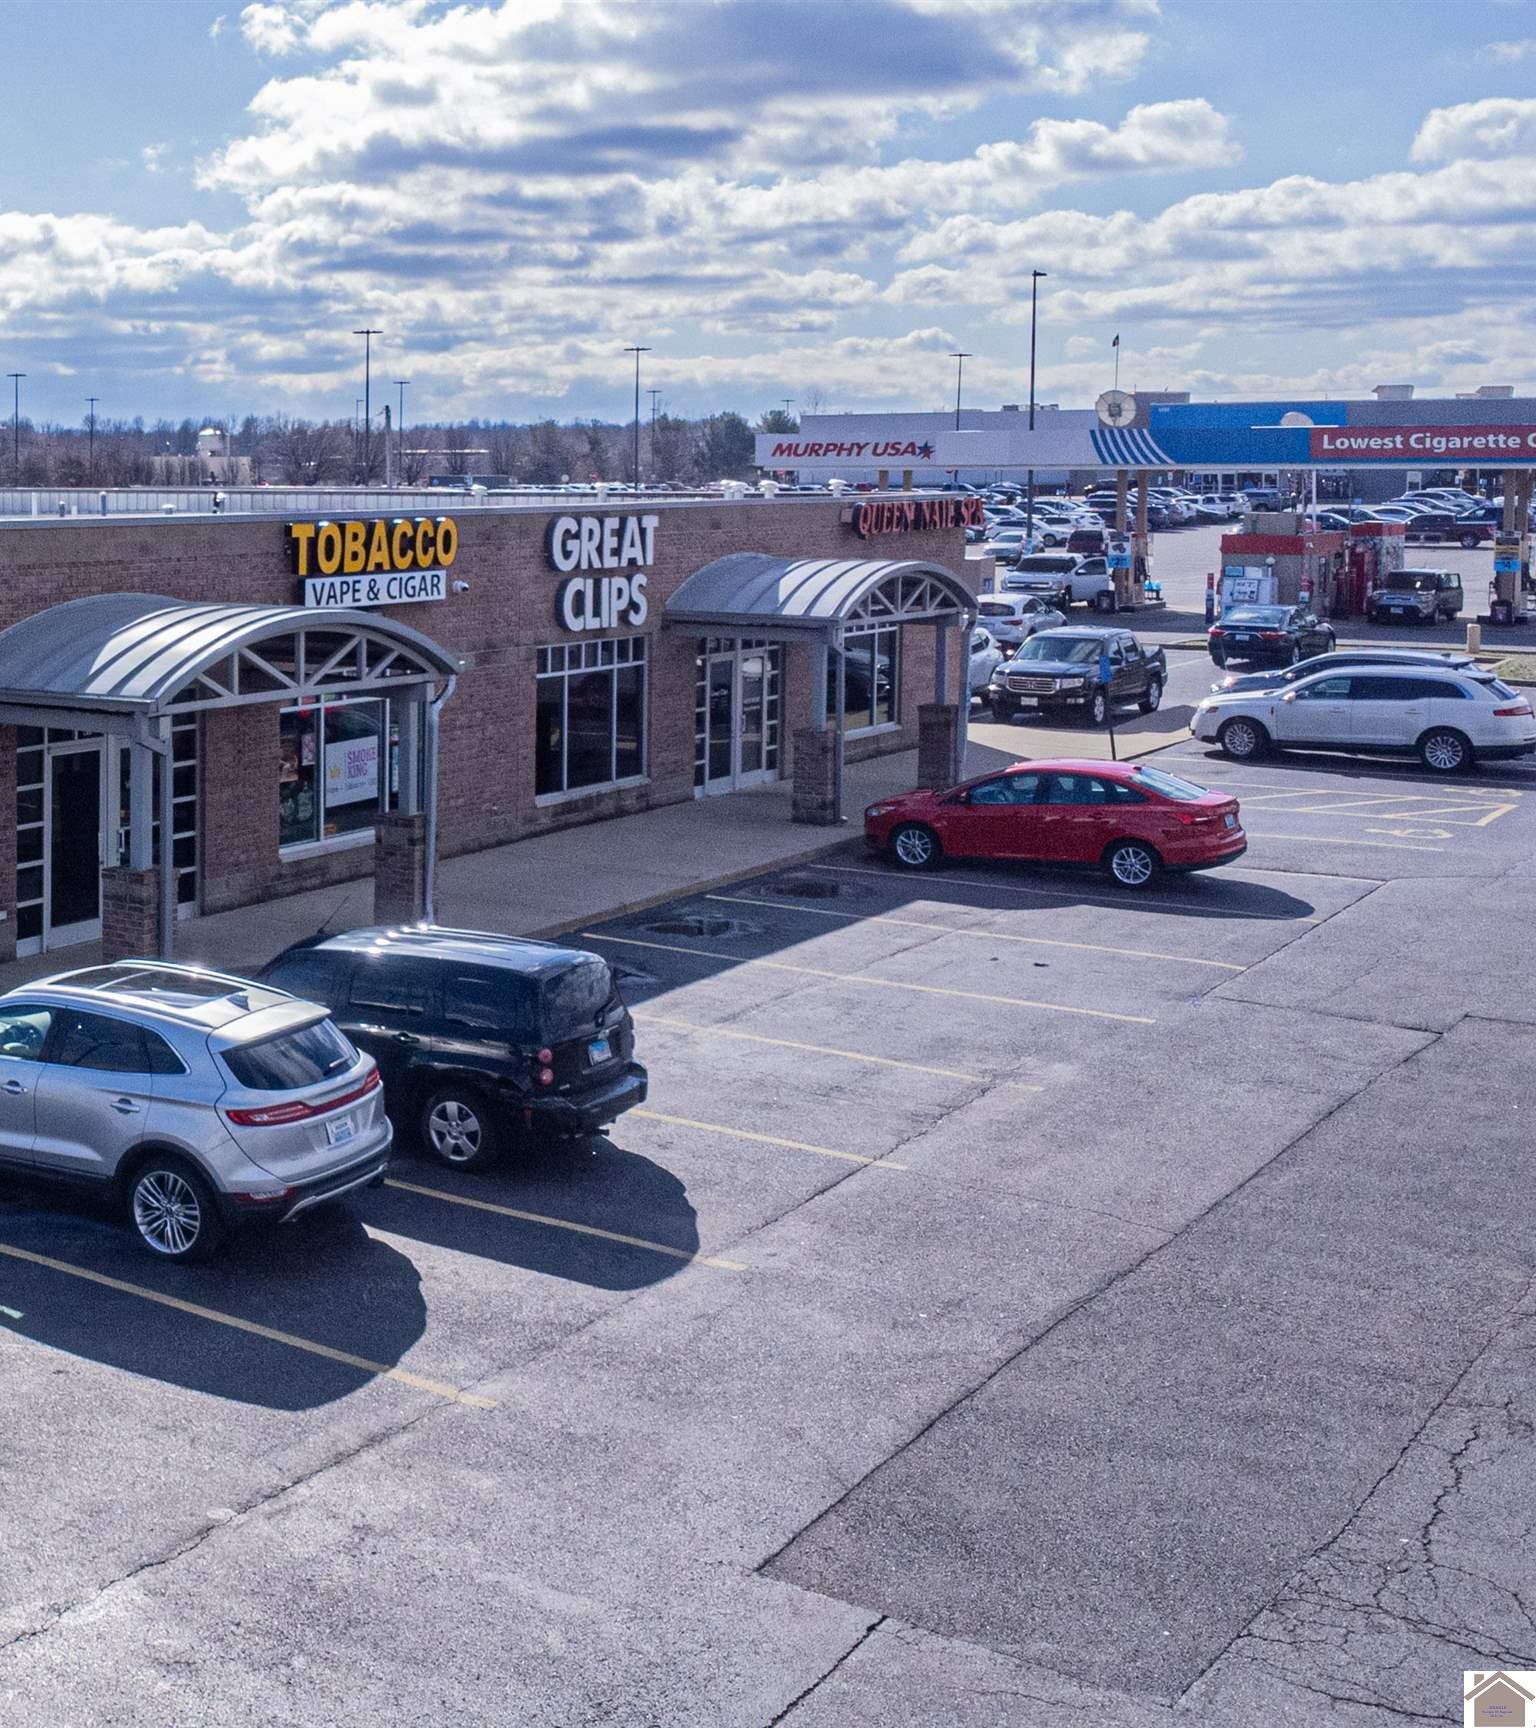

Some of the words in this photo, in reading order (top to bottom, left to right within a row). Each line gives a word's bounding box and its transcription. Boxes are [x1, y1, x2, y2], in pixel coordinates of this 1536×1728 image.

[771, 442, 870, 457] MURPHY
[871, 441, 916, 457] USA
[1323, 434, 1404, 449] Lowest
[1409, 432, 1521, 452] Cigarette
[859, 502, 914, 535] QUEEN
[921, 500, 955, 529] NAIL
[290, 517, 458, 576] TOBACCO
[550, 514, 660, 573] GREAT
[312, 578, 363, 606] VAPE
[367, 577, 381, 602] &
[387, 573, 442, 600] CIGAR
[560, 574, 648, 632] CLIPS
